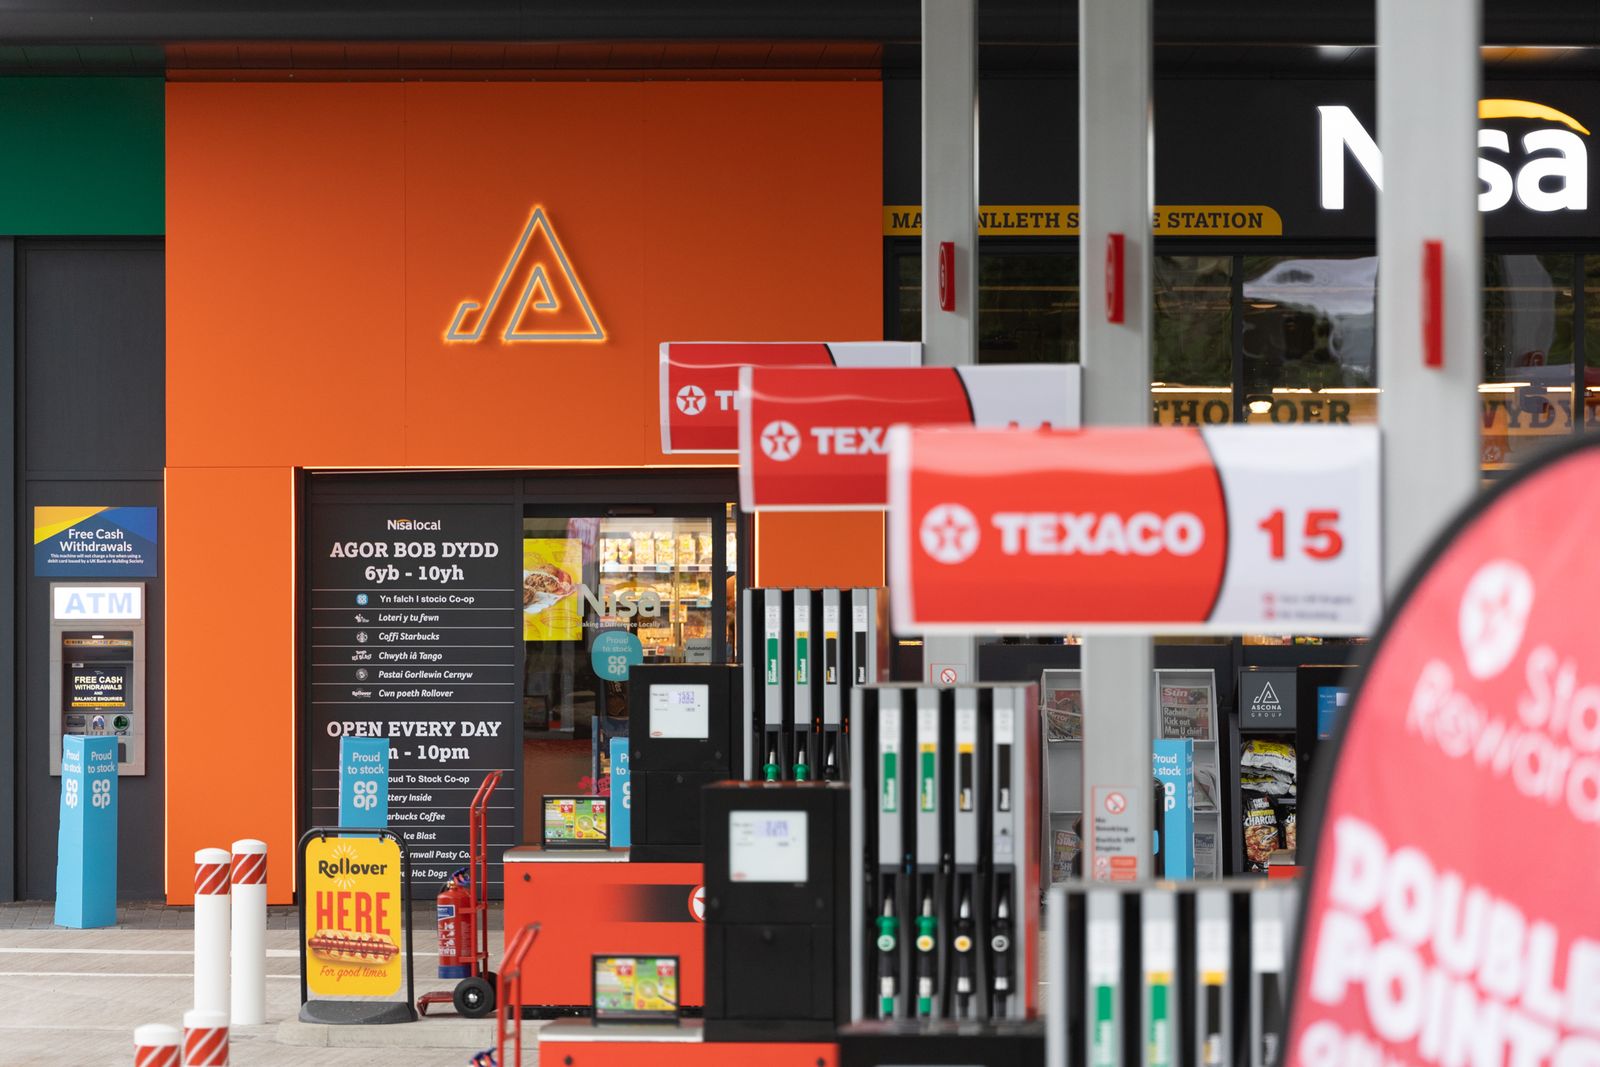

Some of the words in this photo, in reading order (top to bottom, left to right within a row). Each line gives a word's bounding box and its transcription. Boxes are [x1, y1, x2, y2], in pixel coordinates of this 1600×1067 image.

[1316, 104, 1588, 212] Nsa
[892, 212, 1060, 228] MANLLETH
[1168, 212, 1263, 228] STATION
[810, 426, 889, 454] TEX
[68, 528, 94, 540] Free
[96, 528, 124, 540] Cash
[991, 511, 1204, 556] TEXACO
[1257, 507, 1344, 562] 15
[60, 541, 132, 552] Withdrawals
[330, 542, 388, 558] AGOR
[394, 542, 436, 558] BOB
[442, 542, 499, 558] DYDD
[364, 564, 400, 584] 6yb
[418, 564, 464, 584] 10yh
[64, 592, 132, 614] ATM
[380, 595, 392, 603] Yn
[394, 595, 414, 603] falch
[421, 595, 447, 603] stocio
[449, 595, 474, 604] Co-op
[577, 583, 661, 618] Nisa
[378, 614, 402, 622] Loteri
[402, 615, 408, 624] y
[410, 614, 418, 622] tu
[418, 613, 440, 624] fewn
[378, 632, 399, 642] Coffi
[400, 632, 440, 640] Starbucks
[606, 636, 629, 644] Proud
[378, 652, 408, 662] Chwyth
[419, 652, 442, 662] Tango
[74, 676, 97, 684] FREE
[98, 676, 123, 684] CASH
[378, 670, 404, 678] Pastai
[404, 670, 442, 678] Gorllewin
[444, 670, 473, 680] Cernyw
[396, 690, 420, 699] poeth
[326, 721, 382, 736] OPEN
[388, 721, 456, 737] EVERY
[460, 721, 502, 737] DAY
[91, 750, 112, 761] Proud
[352, 752, 380, 762] Proud
[417, 745, 470, 762] 10pm
[1153, 753, 1177, 763] Proud
[88, 765, 95, 773] to
[96, 762, 115, 773] stock
[348, 766, 356, 774] to
[360, 765, 384, 774] stock
[616, 766, 626, 775] to
[1158, 766, 1182, 776] stock
[444, 776, 470, 785] Co-op
[388, 794, 408, 803] ttery
[409, 794, 432, 802] Inside
[386, 812, 418, 820] arbucks
[420, 812, 446, 822] Coffee
[404, 832, 414, 840] Ice
[416, 832, 436, 840] Blast
[400, 850, 434, 858] Crnwall
[436, 850, 458, 860] Pasty
[318, 858, 388, 878] Rollover
[428, 870, 448, 879] Dogs
[316, 890, 390, 935] HERE
[1329, 814, 1600, 1032] DOUBLE
[320, 965, 335, 976] For
[336, 966, 362, 982] good
[363, 966, 388, 978] times
